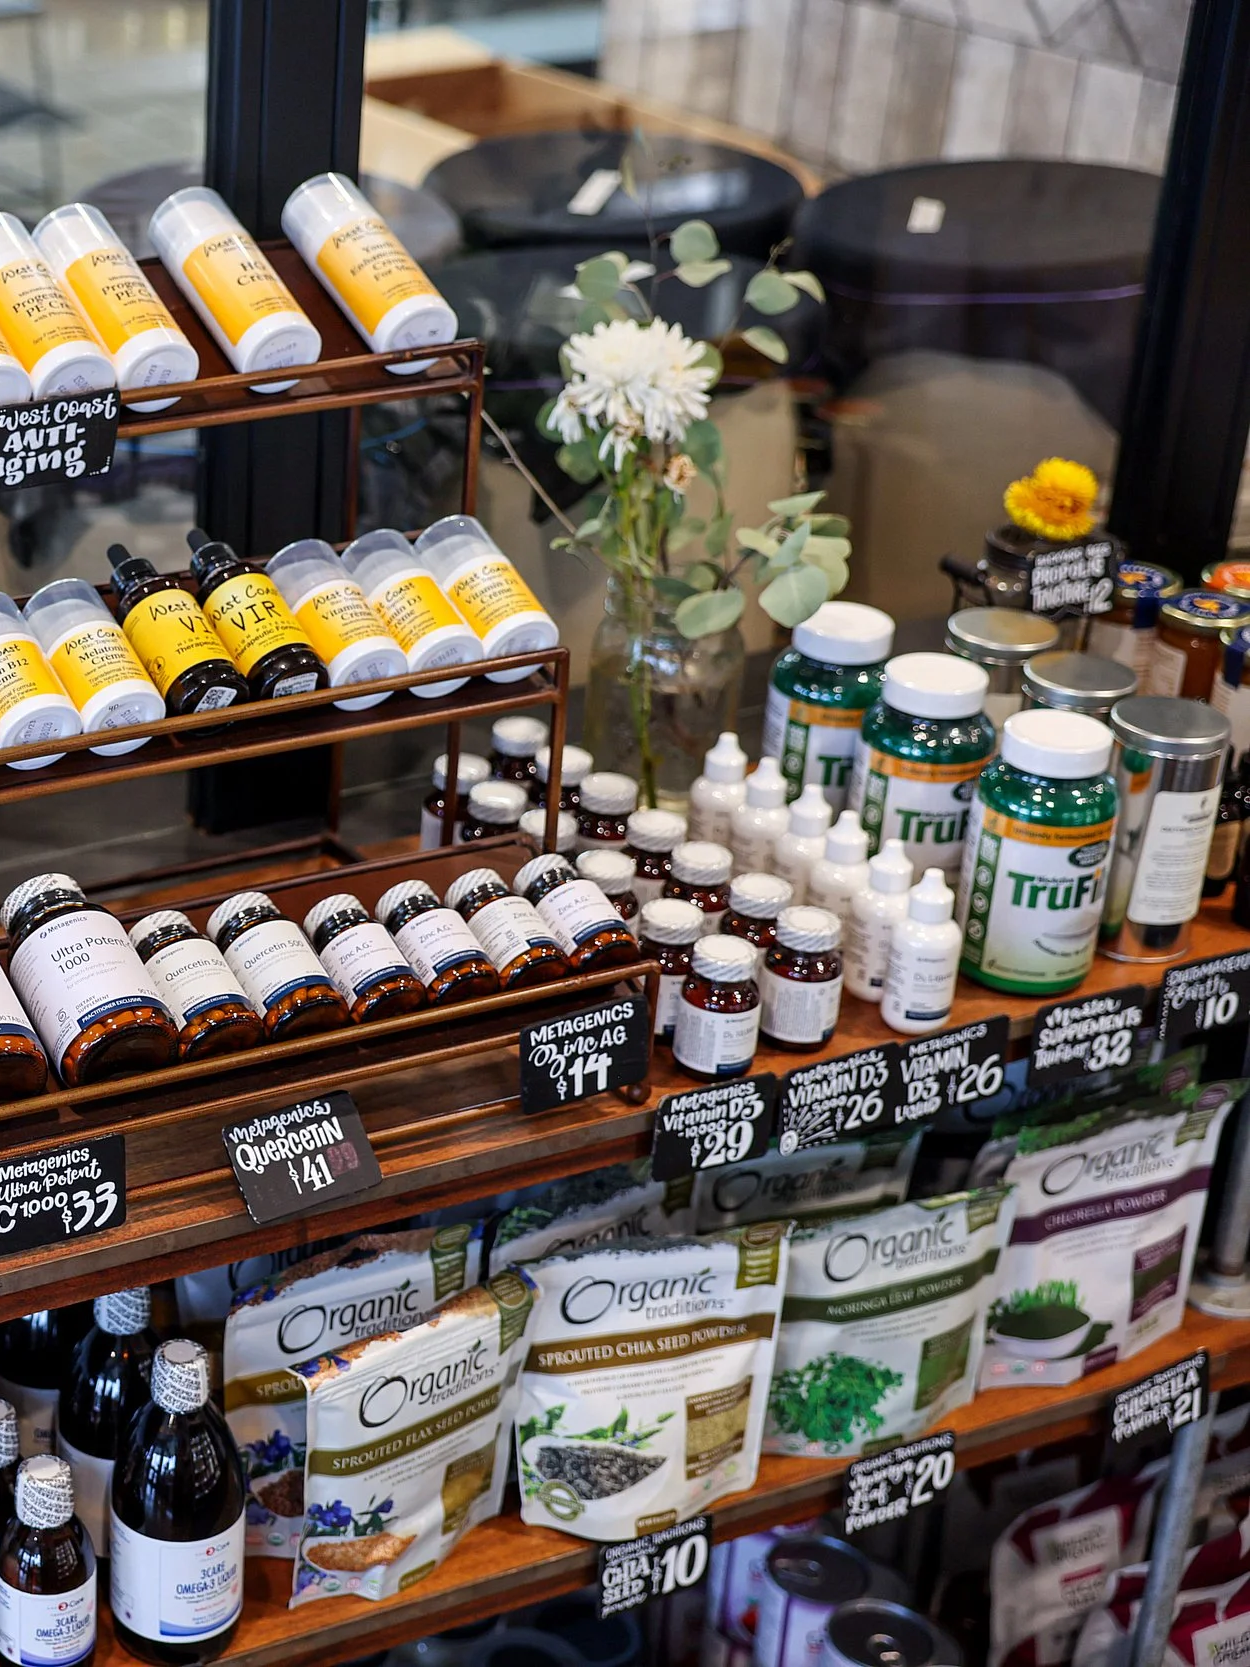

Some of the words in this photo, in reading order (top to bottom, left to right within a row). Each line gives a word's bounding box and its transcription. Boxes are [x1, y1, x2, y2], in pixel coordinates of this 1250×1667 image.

[54, 393, 117, 423] Coast
[3, 422, 85, 452] ANTI-
[230, 600, 281, 631] VIR
[8, 658, 29, 670] B12
[50, 944, 84, 963] Ultra
[57, 953, 91, 974] 1000
[165, 961, 209, 981] Quercetin
[211, 958, 226, 967] 500
[243, 944, 286, 970] Quercetin
[339, 948, 355, 965] Zinc
[530, 1002, 634, 1047] METAGENICS
[599, 1025, 628, 1048] AG
[910, 1023, 988, 1057] METAGENICS
[1039, 1006, 1143, 1048] SUPPLEMENTS
[556, 1052, 613, 1100] $14
[900, 1042, 970, 1083] VITAMIN
[908, 1077, 940, 1103] D3
[947, 1054, 1003, 1104] $26
[671, 1082, 755, 1113] Metagenics
[789, 1068, 858, 1110] VITAMIN
[860, 1060, 889, 1089] D3
[663, 1104, 727, 1131] Vitamin
[835, 1089, 884, 1131] $26
[691, 1120, 754, 1168] $29
[43, 1158, 101, 1192] Potent
[288, 1154, 335, 1194] $41
[1042, 1135, 1165, 1195] Organic
[61, 1182, 118, 1234] $33
[1114, 1190, 1167, 1212] POWDER
[824, 1214, 954, 1281] Organic
[561, 1268, 716, 1324] Organic
[646, 1299, 726, 1319] traditions
[827, 1297, 887, 1317] MORINGA
[917, 1275, 964, 1297] POWDER
[278, 1287, 420, 1354] Organic
[539, 1346, 611, 1367] SPROUTED
[616, 1341, 655, 1355] CHIA
[658, 1334, 689, 1351] SEED
[692, 1324, 747, 1344] POWDER
[360, 1348, 488, 1428] Organic
[432, 1364, 496, 1403] traditions
[1114, 1367, 1199, 1426] CHLORELLA
[333, 1440, 403, 1469] SPROUTED
[405, 1424, 434, 1447] FLAX
[435, 1411, 460, 1434] SEED
[176, 1579, 215, 1594] OMEGA-3
[201, 1560, 225, 1579] 3CARE
